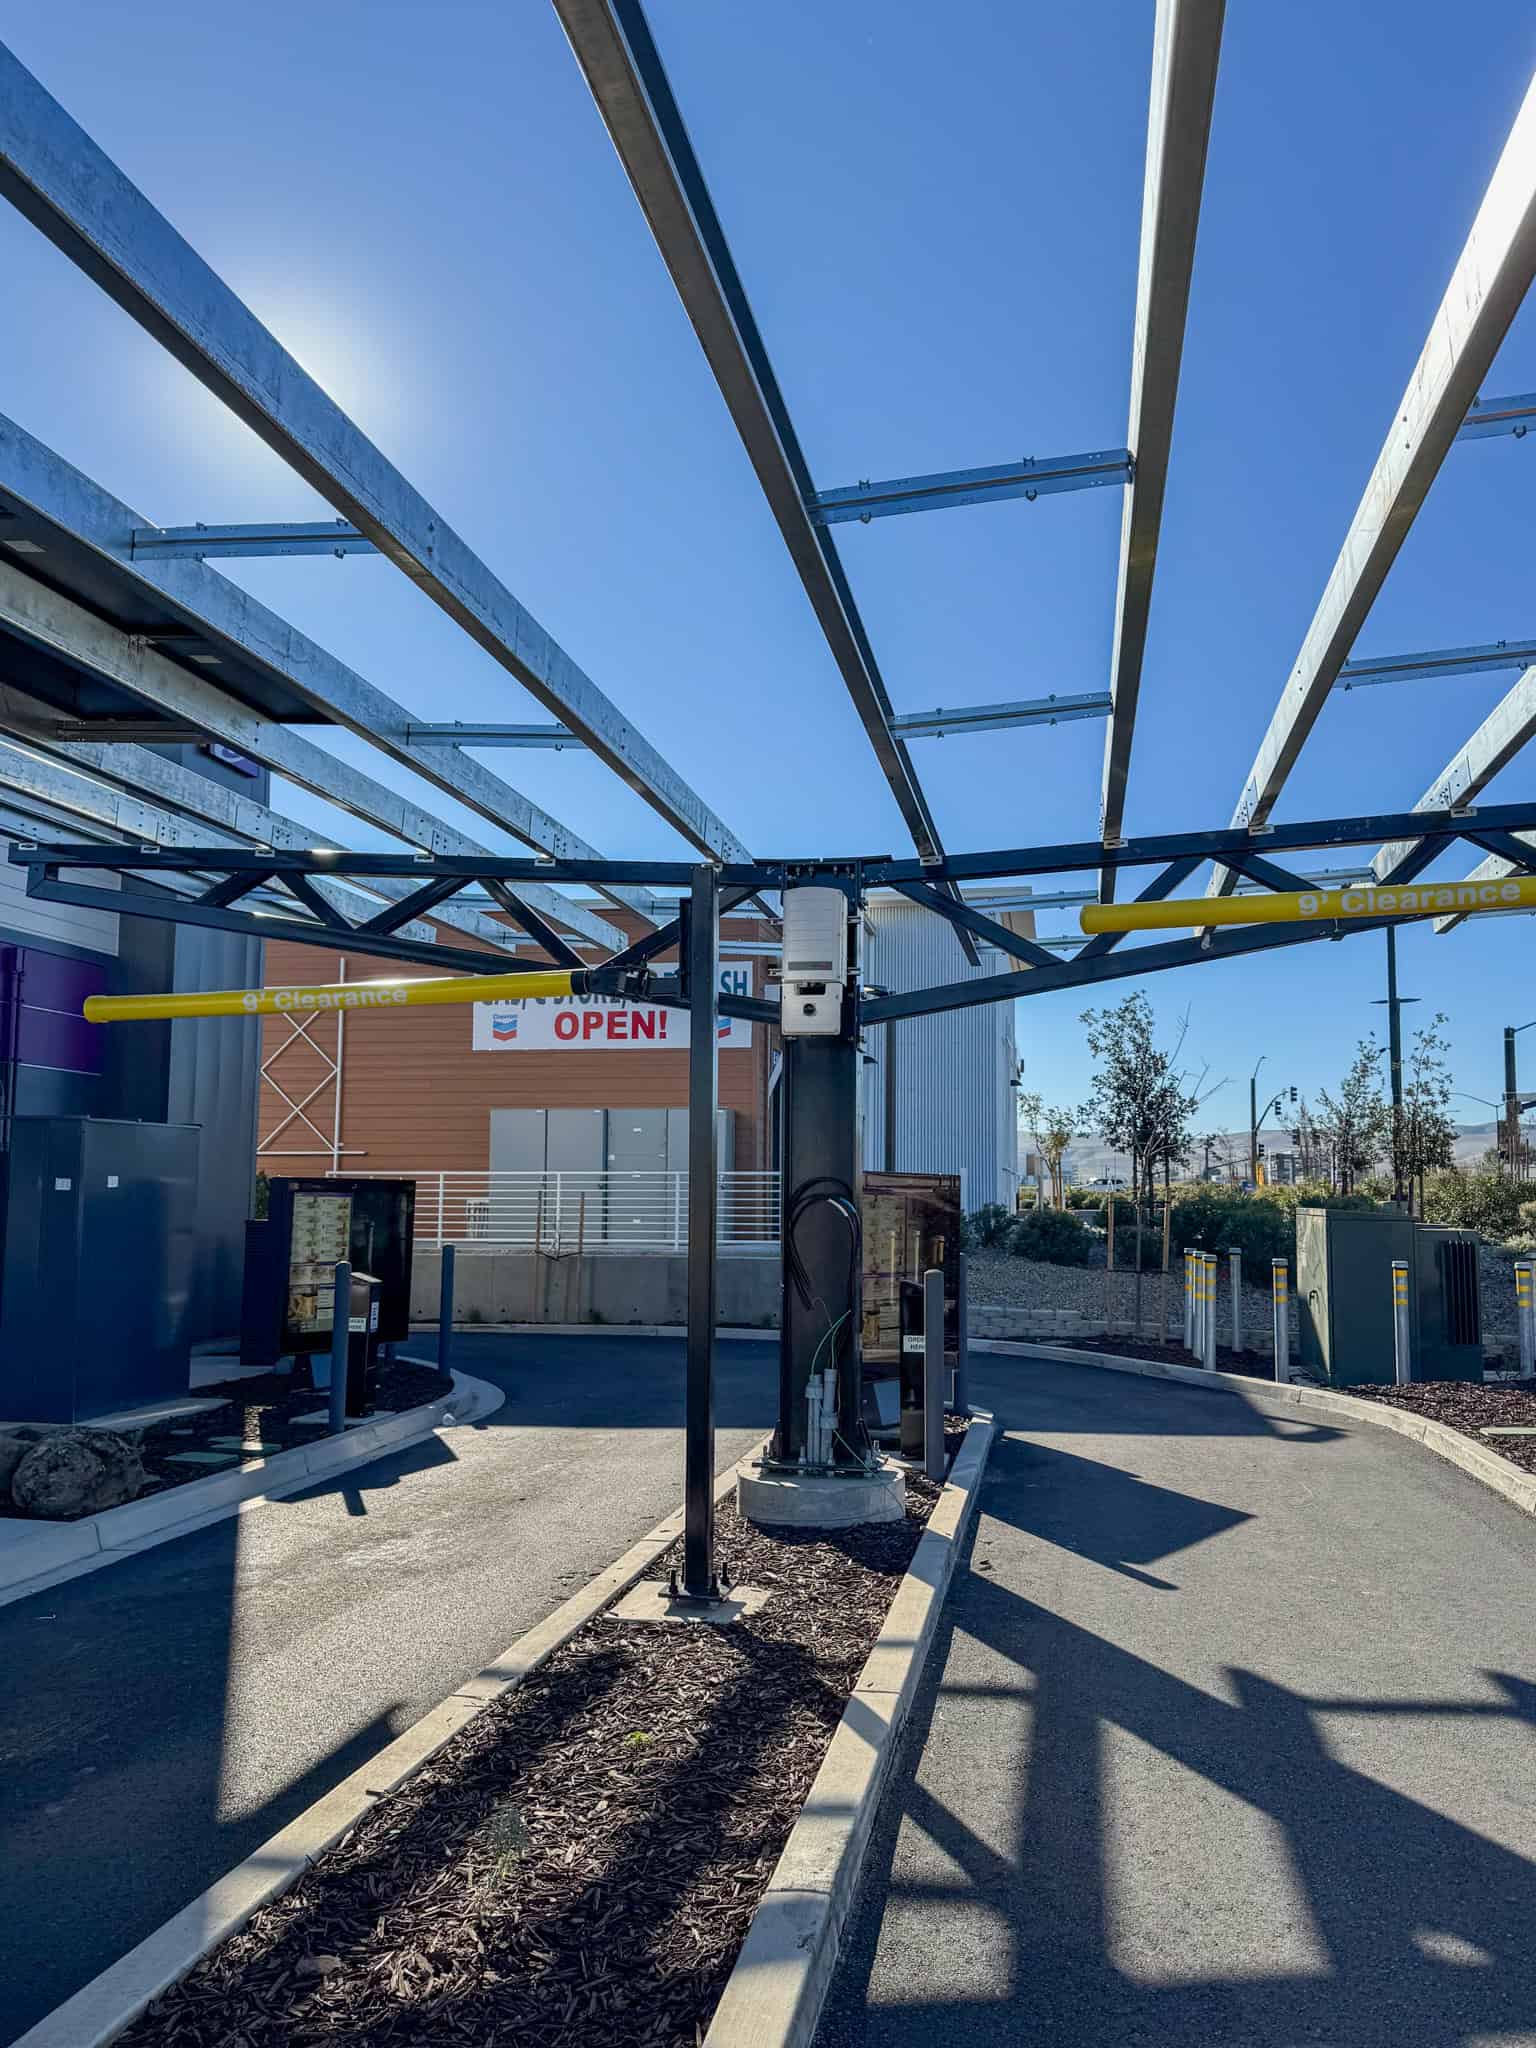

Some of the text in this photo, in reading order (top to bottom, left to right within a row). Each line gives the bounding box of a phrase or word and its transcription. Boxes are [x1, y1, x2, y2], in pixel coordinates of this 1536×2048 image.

[1298, 882, 1521, 916] 9' Clearance
[720, 970, 749, 997] SH
[241, 989, 408, 1011] 9' Clearance
[554, 1011, 667, 1041] OPEN!
